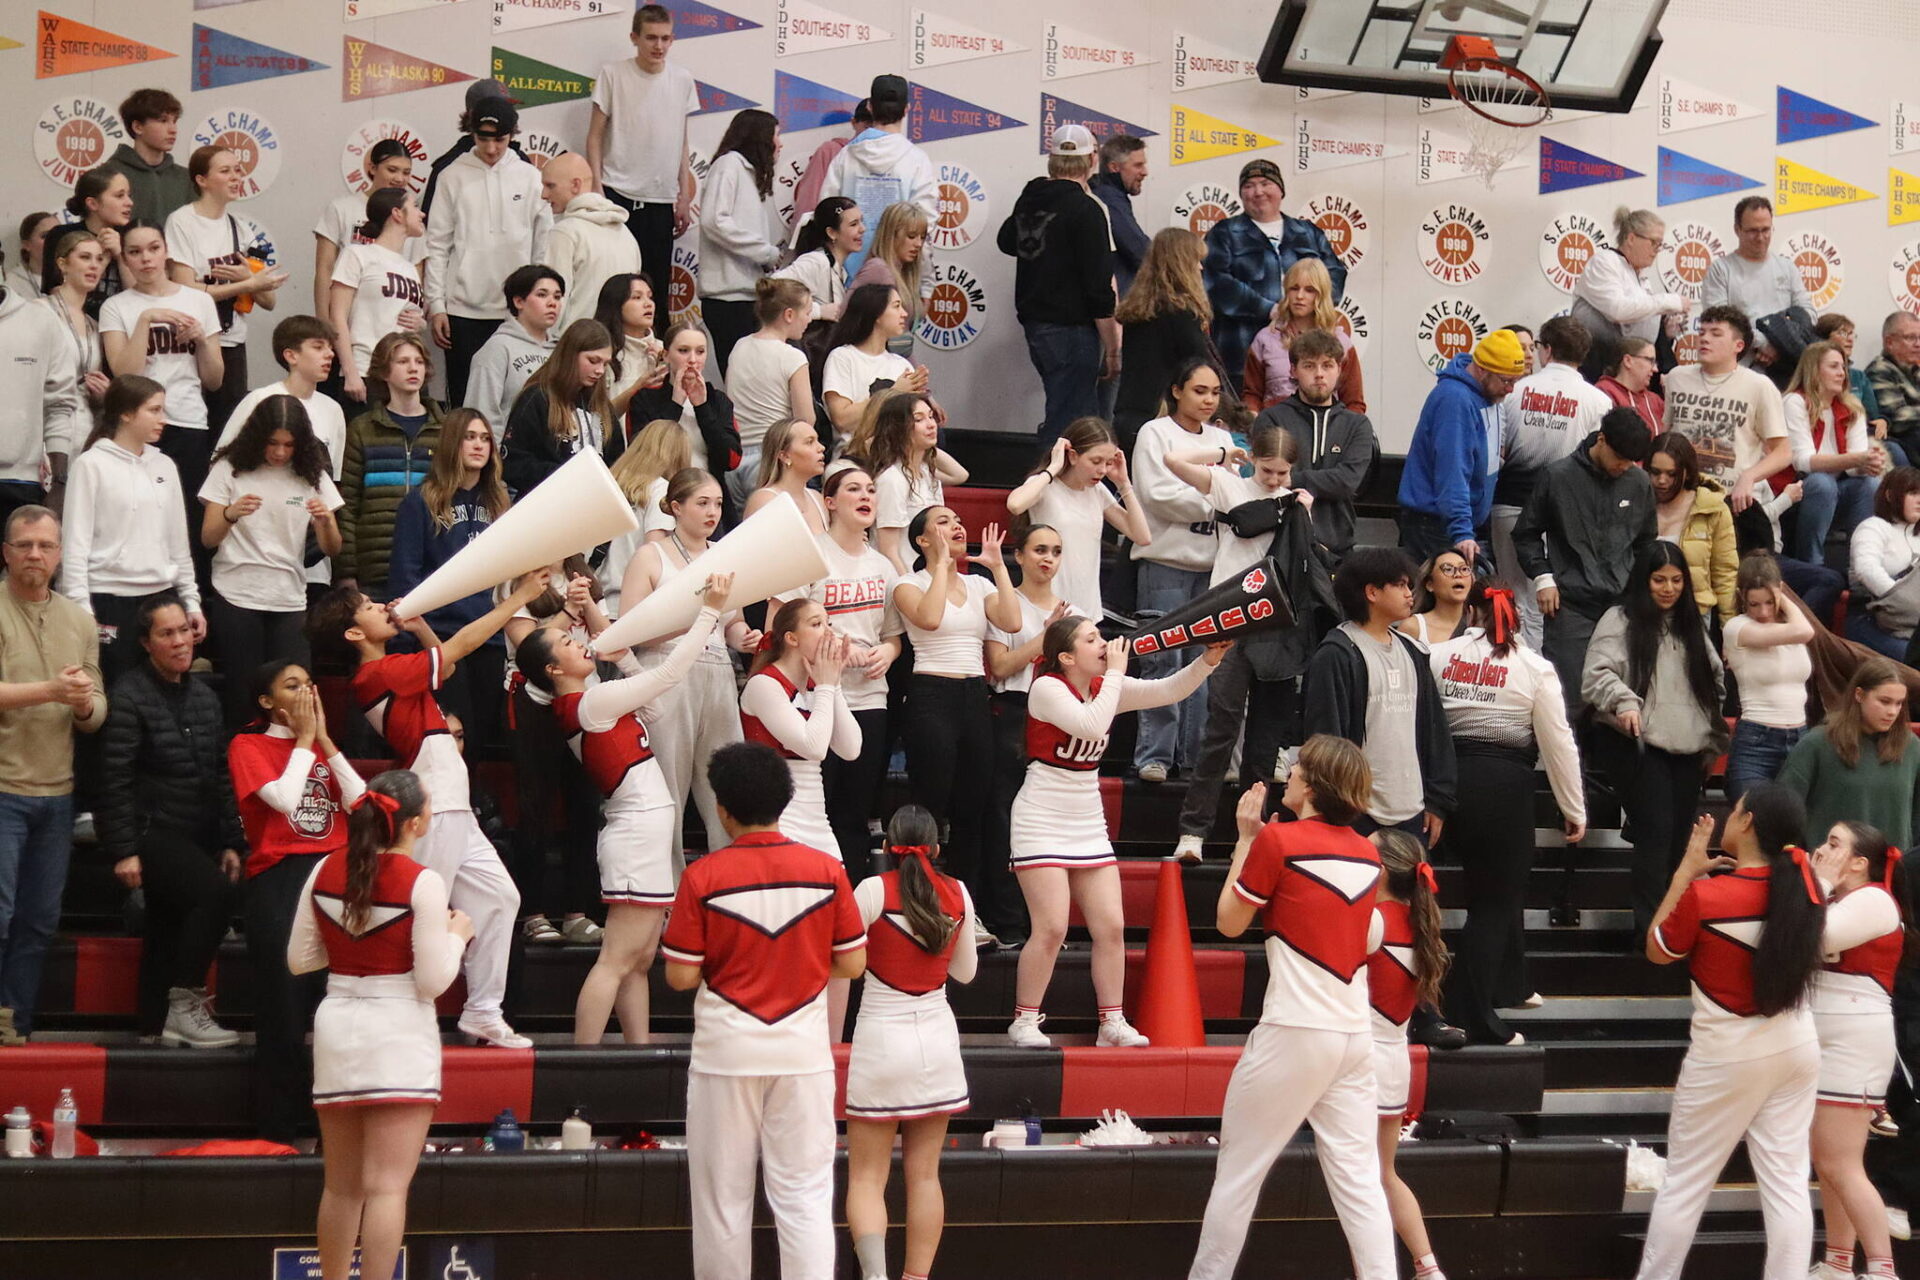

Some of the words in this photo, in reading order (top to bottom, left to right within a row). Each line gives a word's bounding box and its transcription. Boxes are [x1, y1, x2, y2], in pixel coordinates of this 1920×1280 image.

[792, 19, 850, 39] SOUTHEAST
[854, 24, 870, 41] '93
[914, 13, 925, 65] JDHS
[931, 33, 986, 51] SOUTHEAST
[990, 38, 1004, 52] '94
[41, 18, 59, 73] WAHS
[60, 40, 90, 56] STATE
[91, 43, 133, 60] CHAMPS
[1046, 25, 1058, 77] JDHS
[1062, 45, 1116, 64] SOUTHEAST
[1120, 50, 1134, 65] '95
[347, 42, 366, 95] WVHS
[432, 67, 445, 82] 90
[1175, 36, 1187, 87] JDHS
[1190, 56, 1240, 73] SOUTHEAST
[508, 78, 582, 93] ALLSTATE
[912, 88, 923, 139] EAHS
[929, 109, 948, 123] ALL
[951, 110, 982, 126] STATE
[1662, 81, 1672, 129] JDHS
[1693, 103, 1724, 116] CHAMPS
[74, 100, 123, 140] CHAMP
[228, 112, 278, 151] CHAMP
[1895, 103, 1905, 150] JDHS
[65, 136, 96, 151] 1988
[1174, 111, 1186, 159] BHS
[1189, 130, 1206, 144] ALL
[1210, 130, 1238, 145] STATE
[1241, 132, 1257, 148] '96
[1299, 119, 1310, 170] JDHS
[1311, 138, 1338, 154] STATE
[1338, 141, 1372, 156] CHAMPS
[1421, 130, 1432, 180] JDHS
[1437, 150, 1457, 164] STATE
[1553, 159, 1578, 175] STATE
[941, 166, 986, 203] CHAMP
[1779, 165, 1788, 205] KHS
[1791, 181, 1813, 194] STATE
[1815, 183, 1847, 198] CHAMPS
[1894, 175, 1904, 216] BHS
[1202, 186, 1241, 215] CHAM
[1325, 196, 1367, 231] CHAMP
[1449, 205, 1489, 241] CHAMP
[1569, 215, 1610, 250] CHAMP
[933, 228, 971, 247] ITKA
[1442, 237, 1468, 251] 1998
[1803, 233, 1841, 266] CHAMP
[1564, 247, 1589, 259] 1999
[1680, 255, 1707, 269] 2000
[1425, 258, 1481, 282] JUNEAU
[1799, 266, 1822, 278] 2001
[948, 265, 986, 313] CHAMP
[933, 299, 961, 314] 1994
[1340, 296, 1368, 339] HAMP
[1418, 300, 1451, 340] STATE
[1454, 301, 1489, 341] CHAM
[1441, 332, 1467, 346] 1998
[1552, 391, 1579, 418] Bears
[1671, 391, 1725, 409] TOUGH
[1728, 399, 1748, 414] IN
[1523, 410, 1545, 426] Cheer
[1546, 413, 1568, 431] Team
[1671, 406, 1689, 418] HE
[1692, 408, 1747, 427] SNOW
[823, 579, 886, 606] BEARS
[1132, 597, 1275, 657] BEARS
[1479, 657, 1509, 688] Bears
[1444, 682, 1470, 700] Cheer
[1470, 683, 1497, 703] Team
